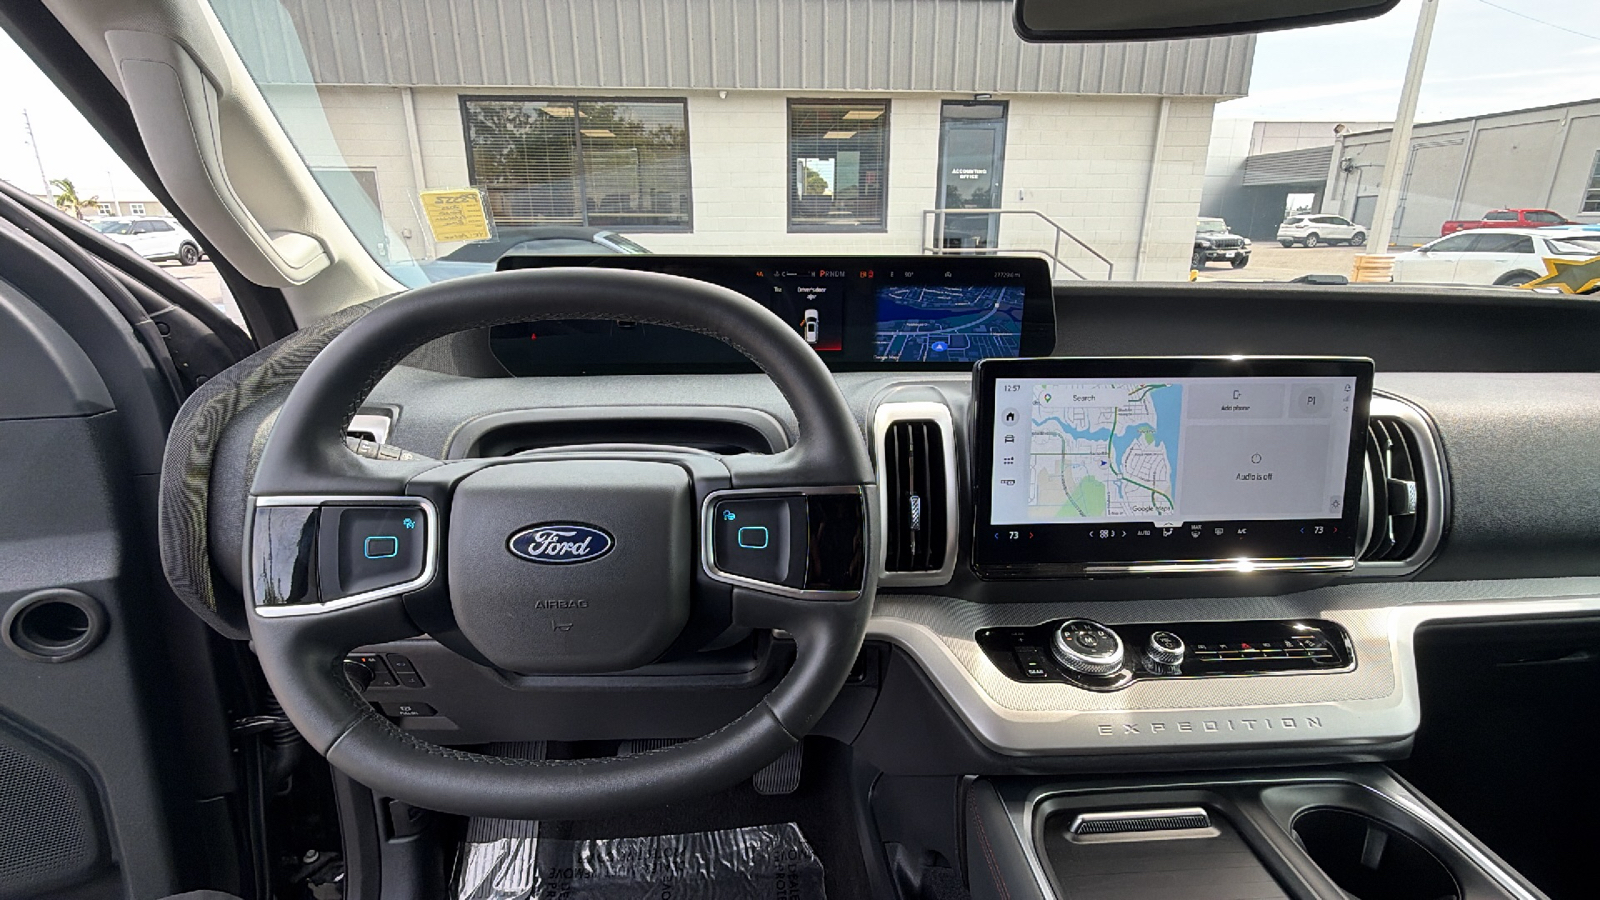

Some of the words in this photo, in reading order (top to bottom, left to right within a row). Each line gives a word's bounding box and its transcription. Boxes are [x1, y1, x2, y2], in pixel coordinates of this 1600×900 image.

[1004, 384, 1021, 392] 12:57
[1072, 394, 1096, 402] Search
[1236, 473, 1255, 481] Audio
[1263, 473, 1273, 481] off
[1132, 505, 1154, 513] Google
[1314, 526, 1324, 534] 73
[1009, 531, 1019, 539] 73
[528, 530, 593, 556] Ford
[534, 599, 589, 609] AIRBAG
[1097, 716, 1324, 737] EXPEDITION
